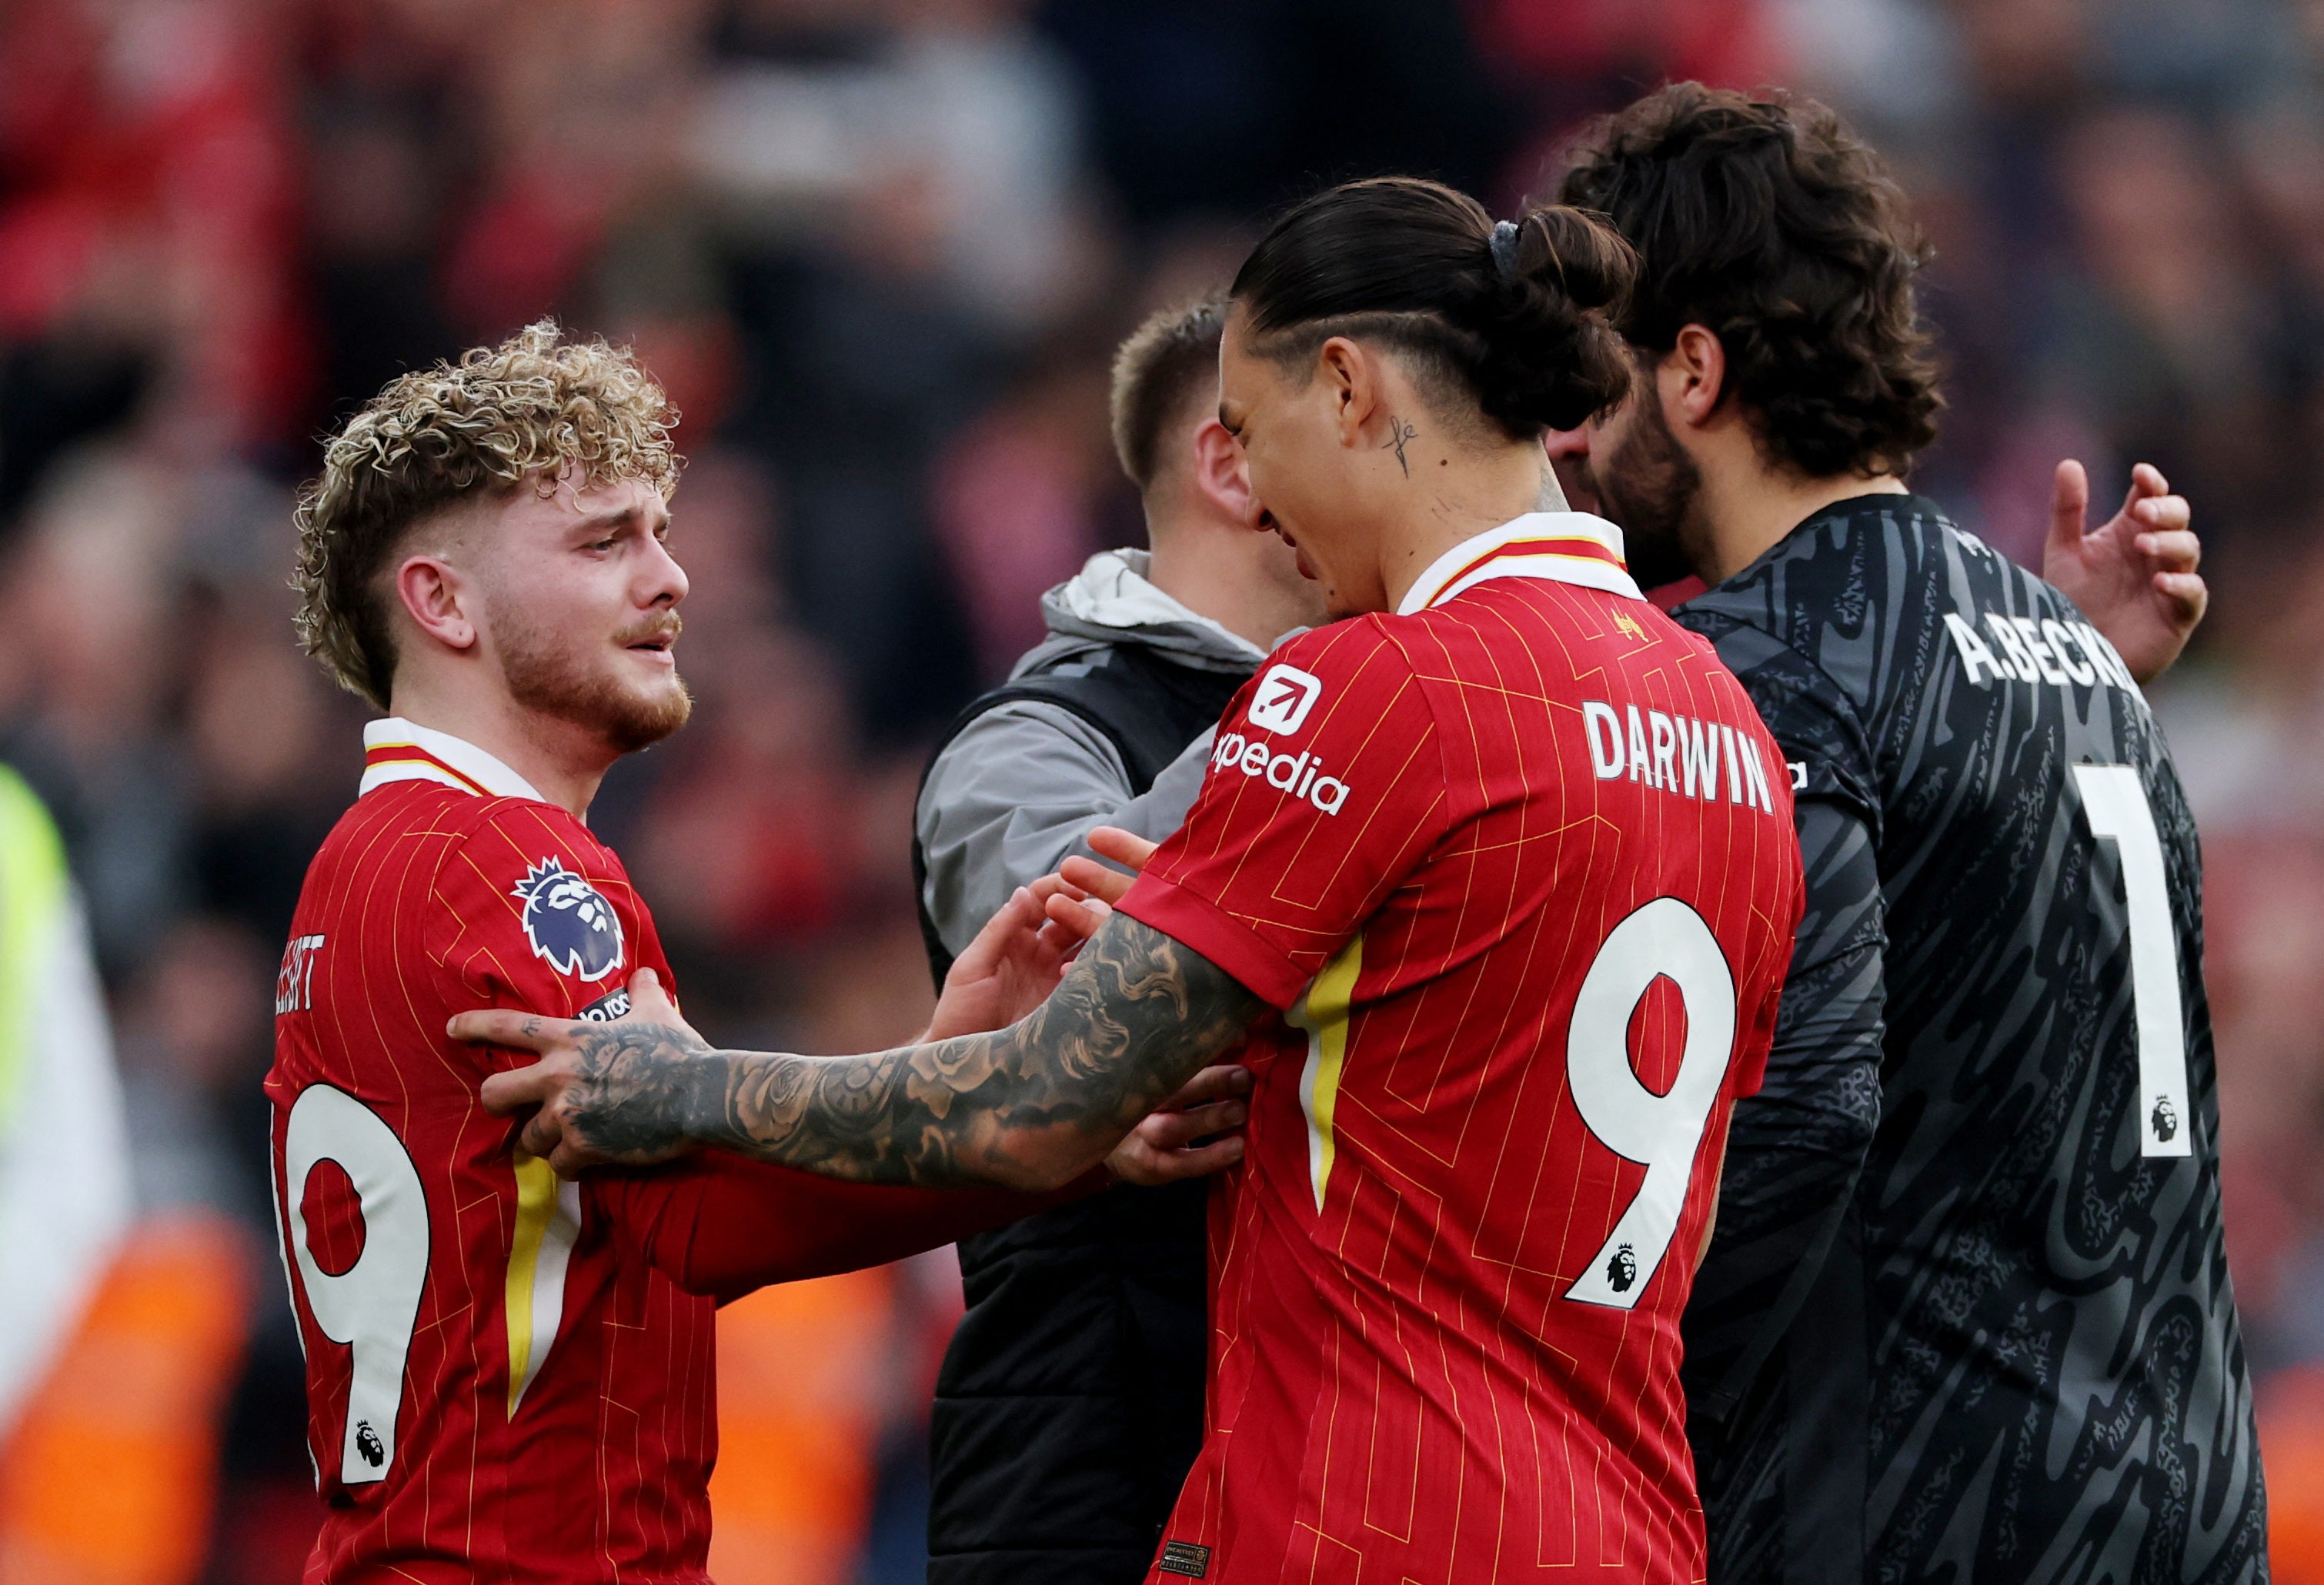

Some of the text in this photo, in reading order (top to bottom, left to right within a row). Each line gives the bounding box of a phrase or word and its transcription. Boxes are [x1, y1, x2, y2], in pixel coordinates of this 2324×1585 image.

[1210, 732, 1351, 816] xpedia
[1582, 699, 1773, 816] DARWIN
[1942, 612, 2152, 714] A.BECK
[2072, 762, 2192, 1157] 1
[1561, 895, 1737, 1310] 9
[271, 1083, 432, 1490] 9
